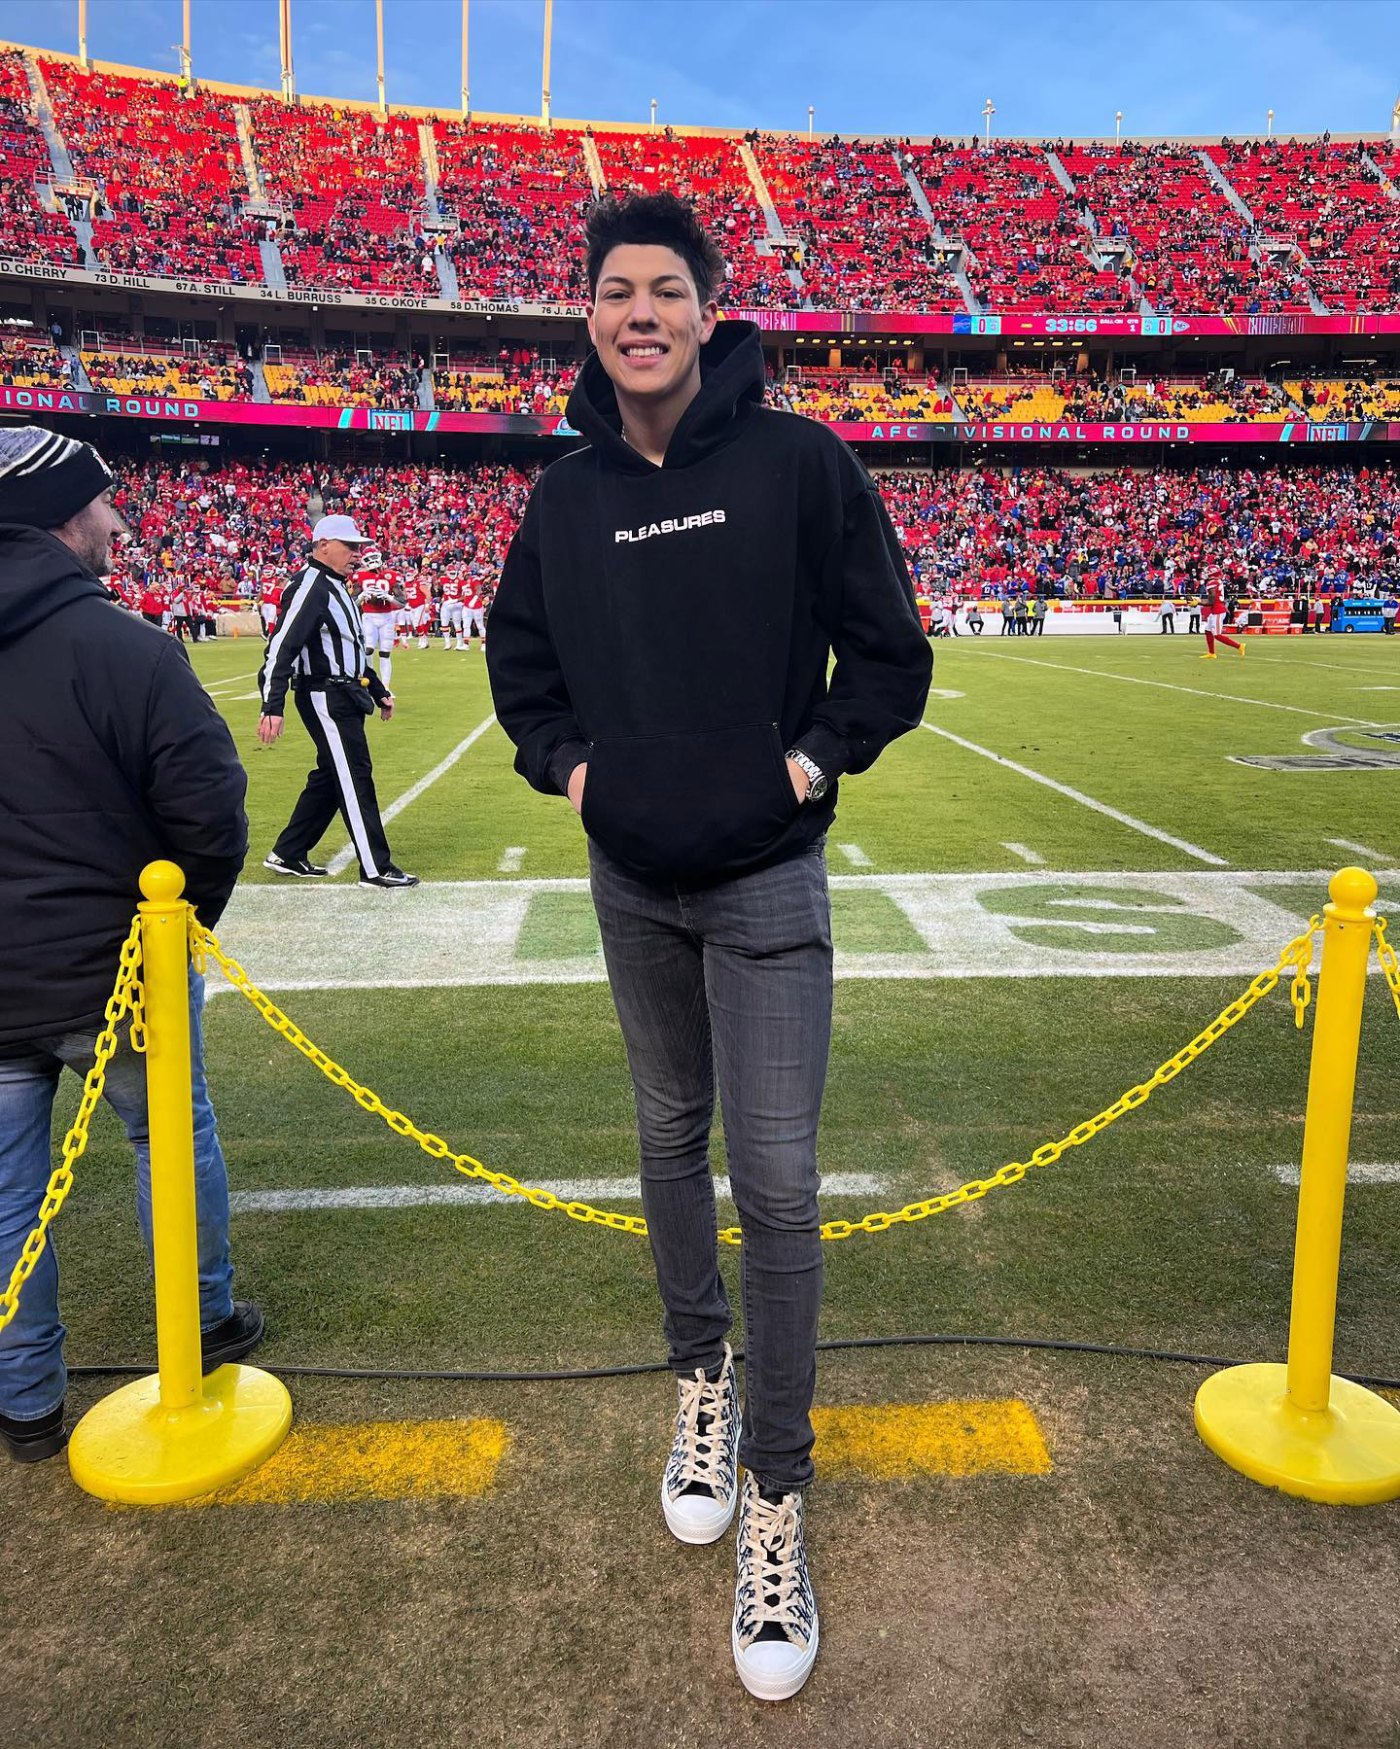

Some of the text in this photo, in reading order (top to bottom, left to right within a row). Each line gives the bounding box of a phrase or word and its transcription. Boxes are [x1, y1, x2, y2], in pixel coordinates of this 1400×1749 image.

[14, 263, 67, 279] CHERRY
[95, 273, 107, 283] 73
[123, 276, 150, 288] HILL
[176, 282, 187, 291] 67
[204, 284, 236, 296] STILL
[260, 289, 273, 298] 34
[287, 291, 342, 304] BURRUSS
[365, 296, 377, 305] 35
[391, 297, 428, 308] OKOYE
[450, 301, 462, 310] 58
[541, 306, 552, 315] 76
[565, 307, 583, 316] ALT
[979, 318, 986, 333] 0
[1045, 318, 1098, 332] 33:56
[1159, 318, 1166, 333] 0
[5, 390, 200, 417] IONAL ROUND
[374, 415, 403, 430] NFL
[871, 425, 918, 438] AFC
[1103, 426, 1189, 439] ROUND
[1313, 428, 1340, 441] NFL
[614, 510, 726, 543] PLEASURES
